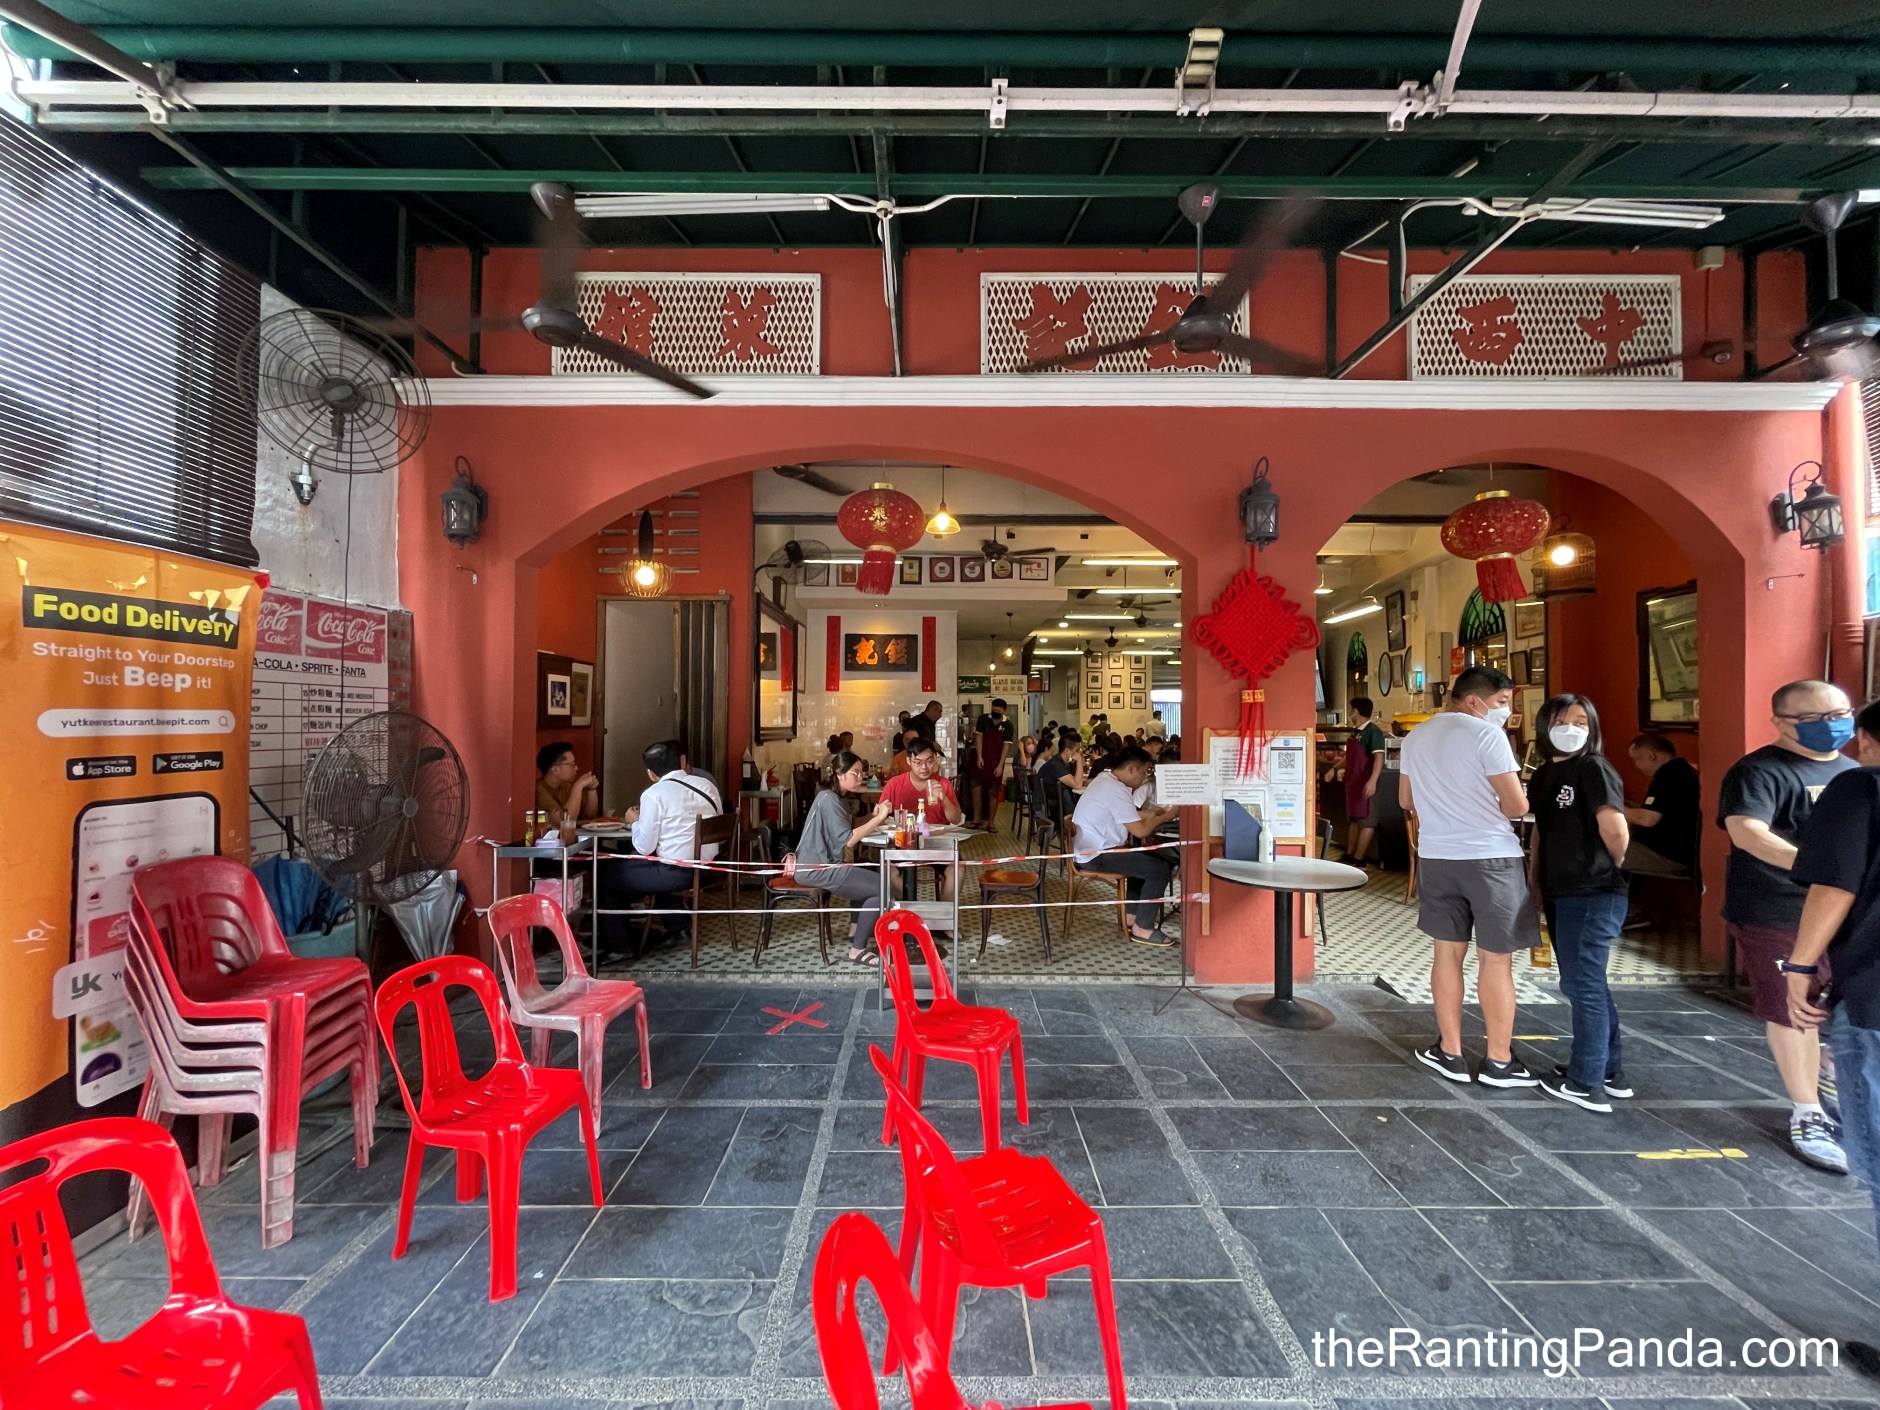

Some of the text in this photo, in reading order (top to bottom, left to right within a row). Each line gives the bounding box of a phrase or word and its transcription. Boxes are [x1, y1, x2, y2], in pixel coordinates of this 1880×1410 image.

[34, 594, 234, 642] Food Delivery
[32, 641, 235, 670] Straight to Your Doorstep
[301, 662, 334, 675] SPRITE
[82, 665, 211, 693] Just Beep it!
[87, 764, 132, 776] App Store
[170, 758, 221, 770] Google Play
